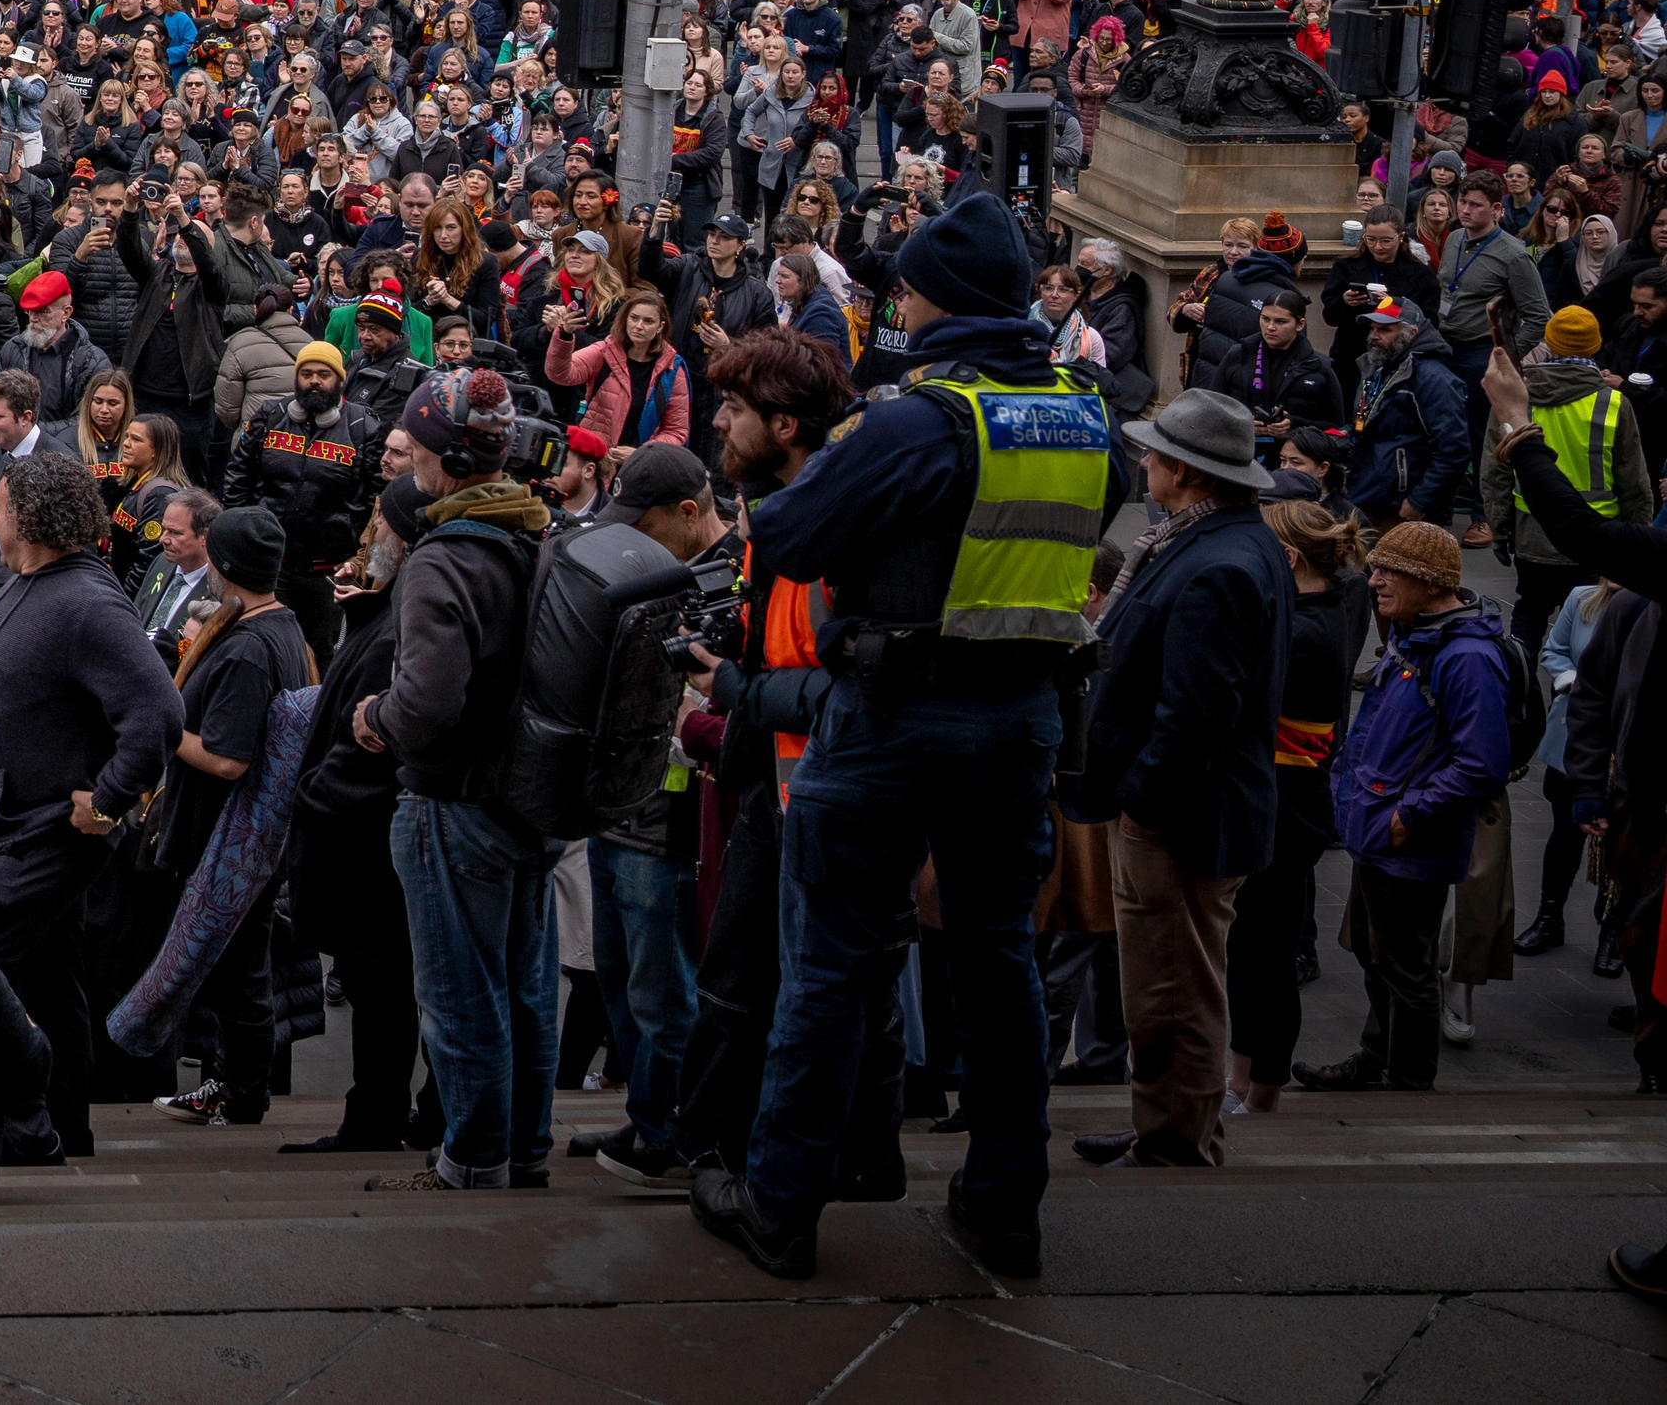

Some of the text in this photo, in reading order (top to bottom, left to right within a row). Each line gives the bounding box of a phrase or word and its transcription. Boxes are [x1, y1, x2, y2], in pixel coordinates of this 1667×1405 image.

[66, 73, 94, 85] Human
[995, 406, 1094, 425] Protective
[1011, 424, 1092, 444] Services
[263, 430, 357, 466] TREATY
